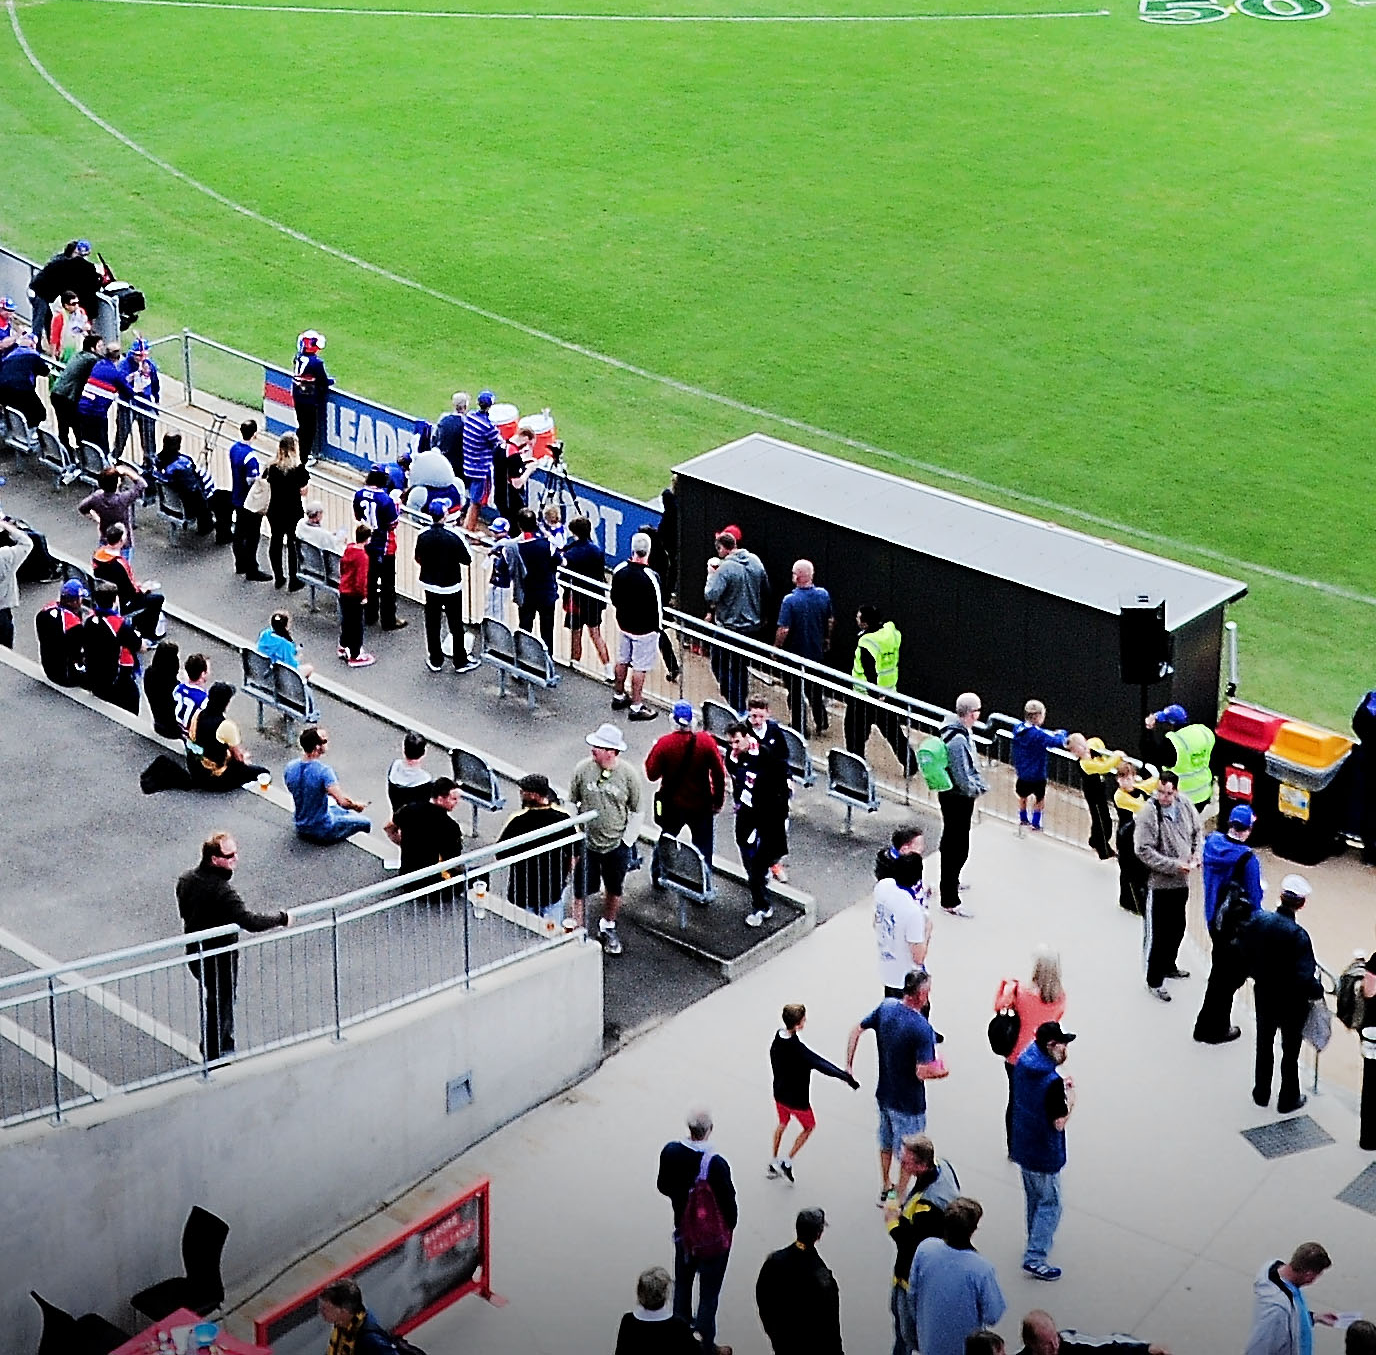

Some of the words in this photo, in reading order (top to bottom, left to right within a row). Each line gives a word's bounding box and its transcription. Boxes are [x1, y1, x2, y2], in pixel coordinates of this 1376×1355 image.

[326, 402, 416, 463] LEADE
[528, 478, 624, 557] PORT
[360, 500, 379, 531] 31
